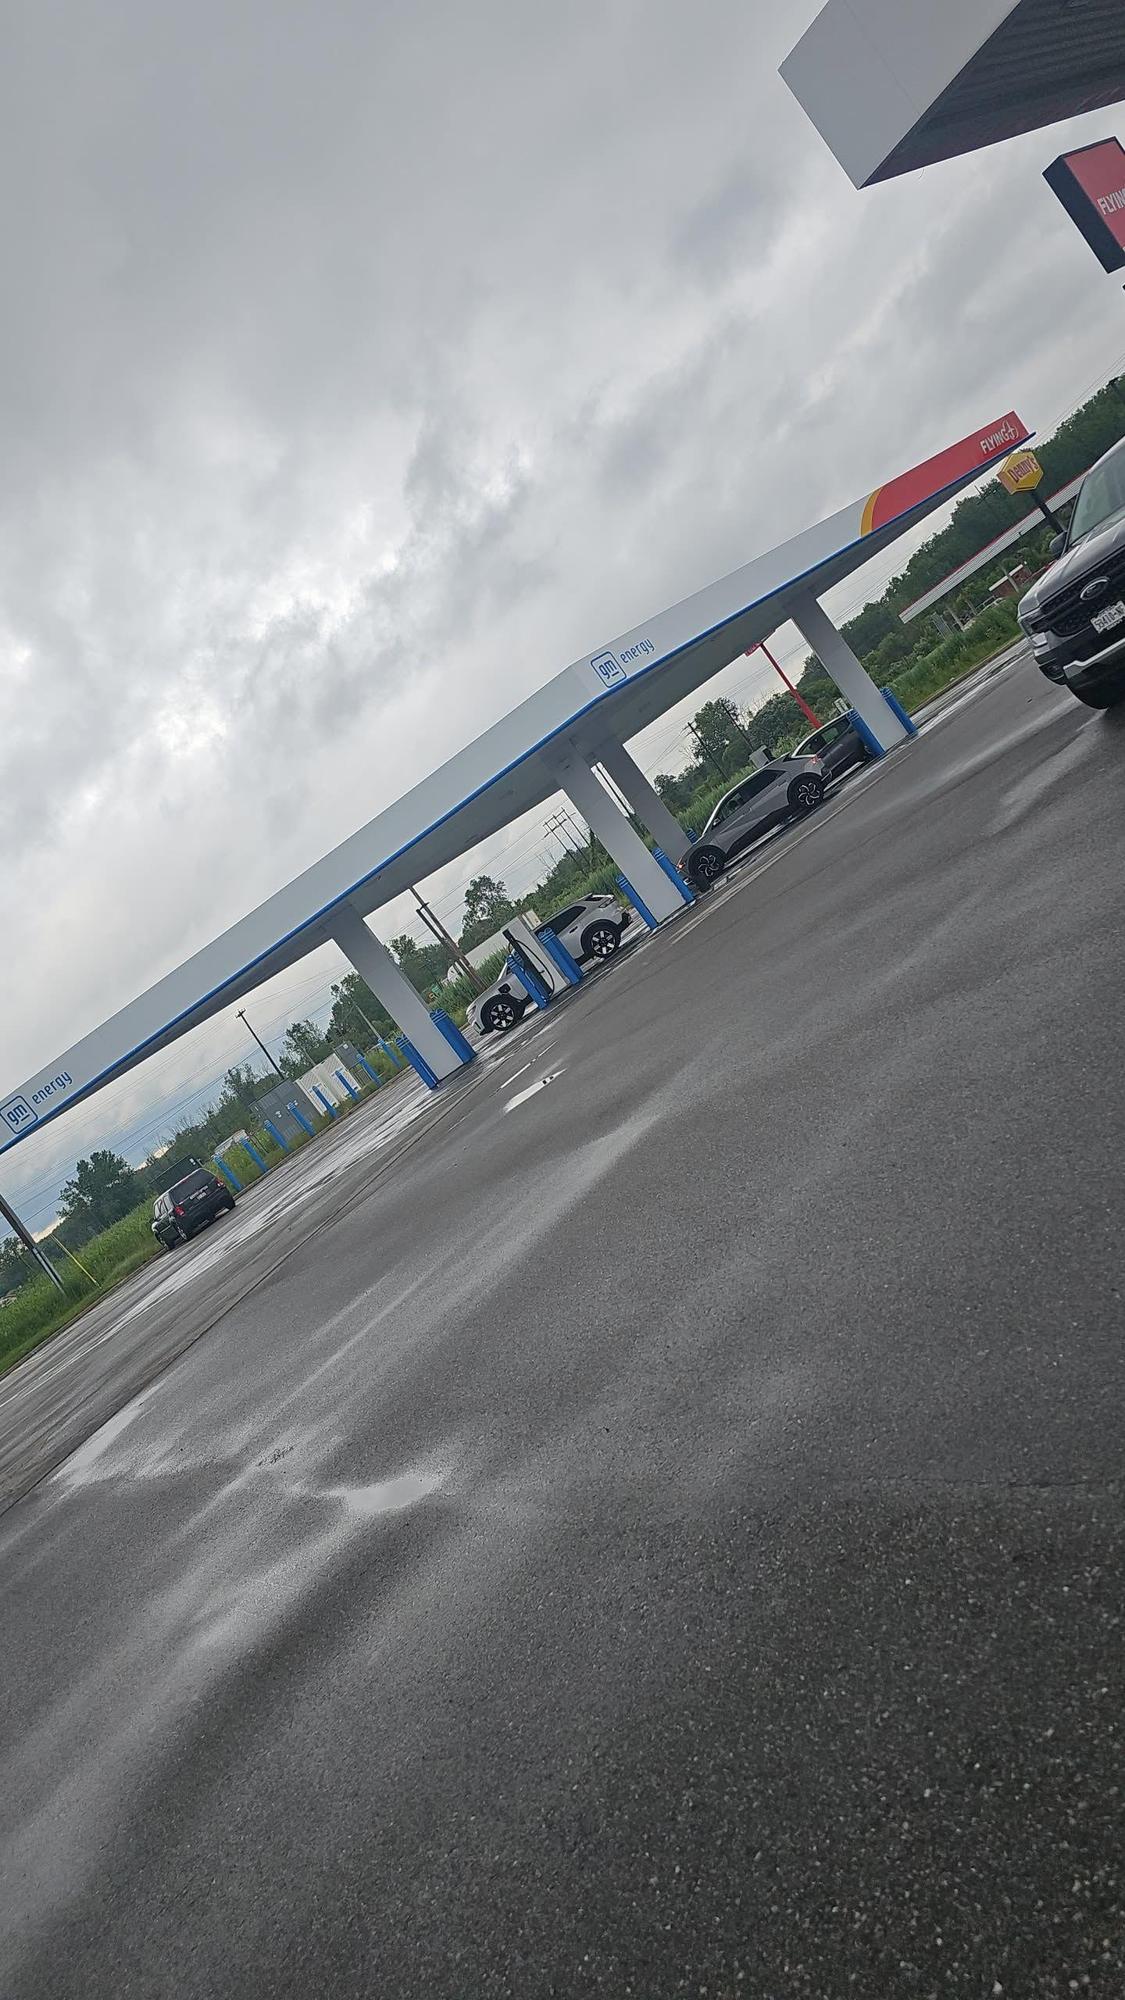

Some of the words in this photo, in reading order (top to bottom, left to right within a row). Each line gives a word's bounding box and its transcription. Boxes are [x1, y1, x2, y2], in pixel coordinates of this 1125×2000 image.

[980, 428, 1011, 454] FLYING
[620, 638, 655, 664] energy
[6, 1104, 29, 1126] gm
[31, 1071, 73, 1105] energy
